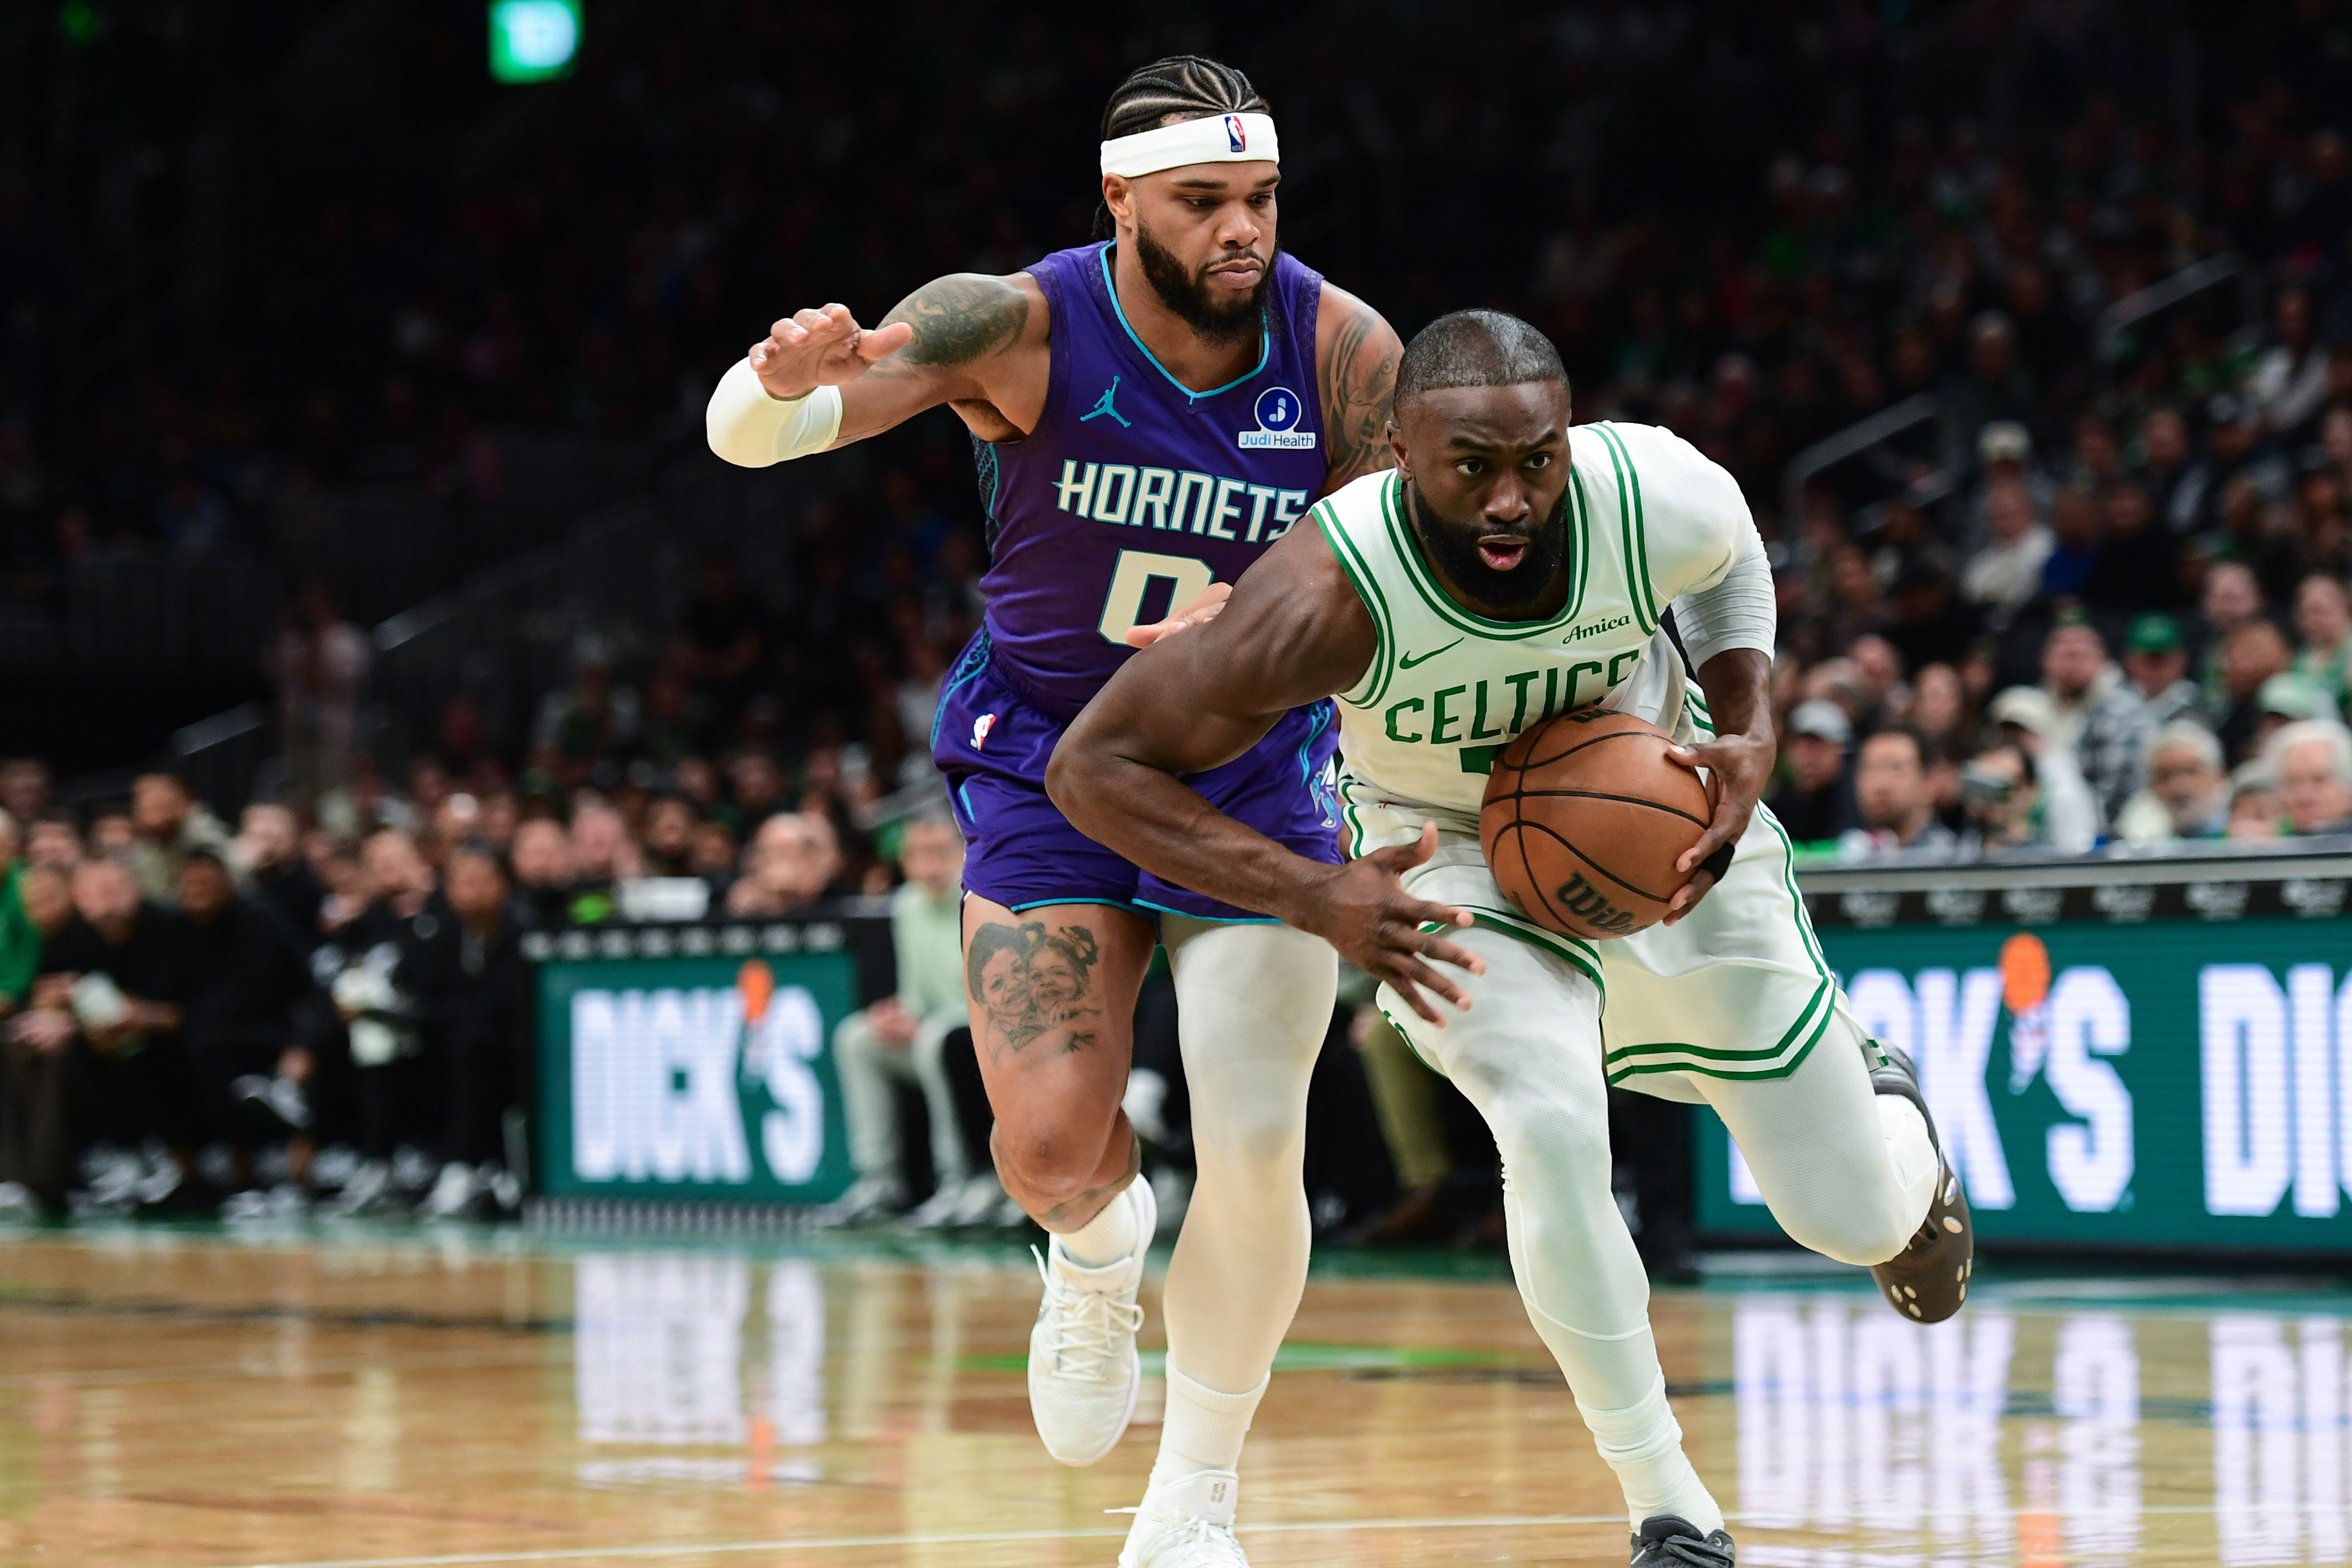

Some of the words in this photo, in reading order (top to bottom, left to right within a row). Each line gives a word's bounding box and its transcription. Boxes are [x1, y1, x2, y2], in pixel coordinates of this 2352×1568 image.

[1241, 434, 1271, 446] Judi
[1274, 434, 1313, 447] Health
[1052, 459, 1308, 542] HORNETS
[1562, 615, 1631, 644] Amica
[1556, 871, 1647, 937] Wil
[2198, 963, 2352, 1218] DI
